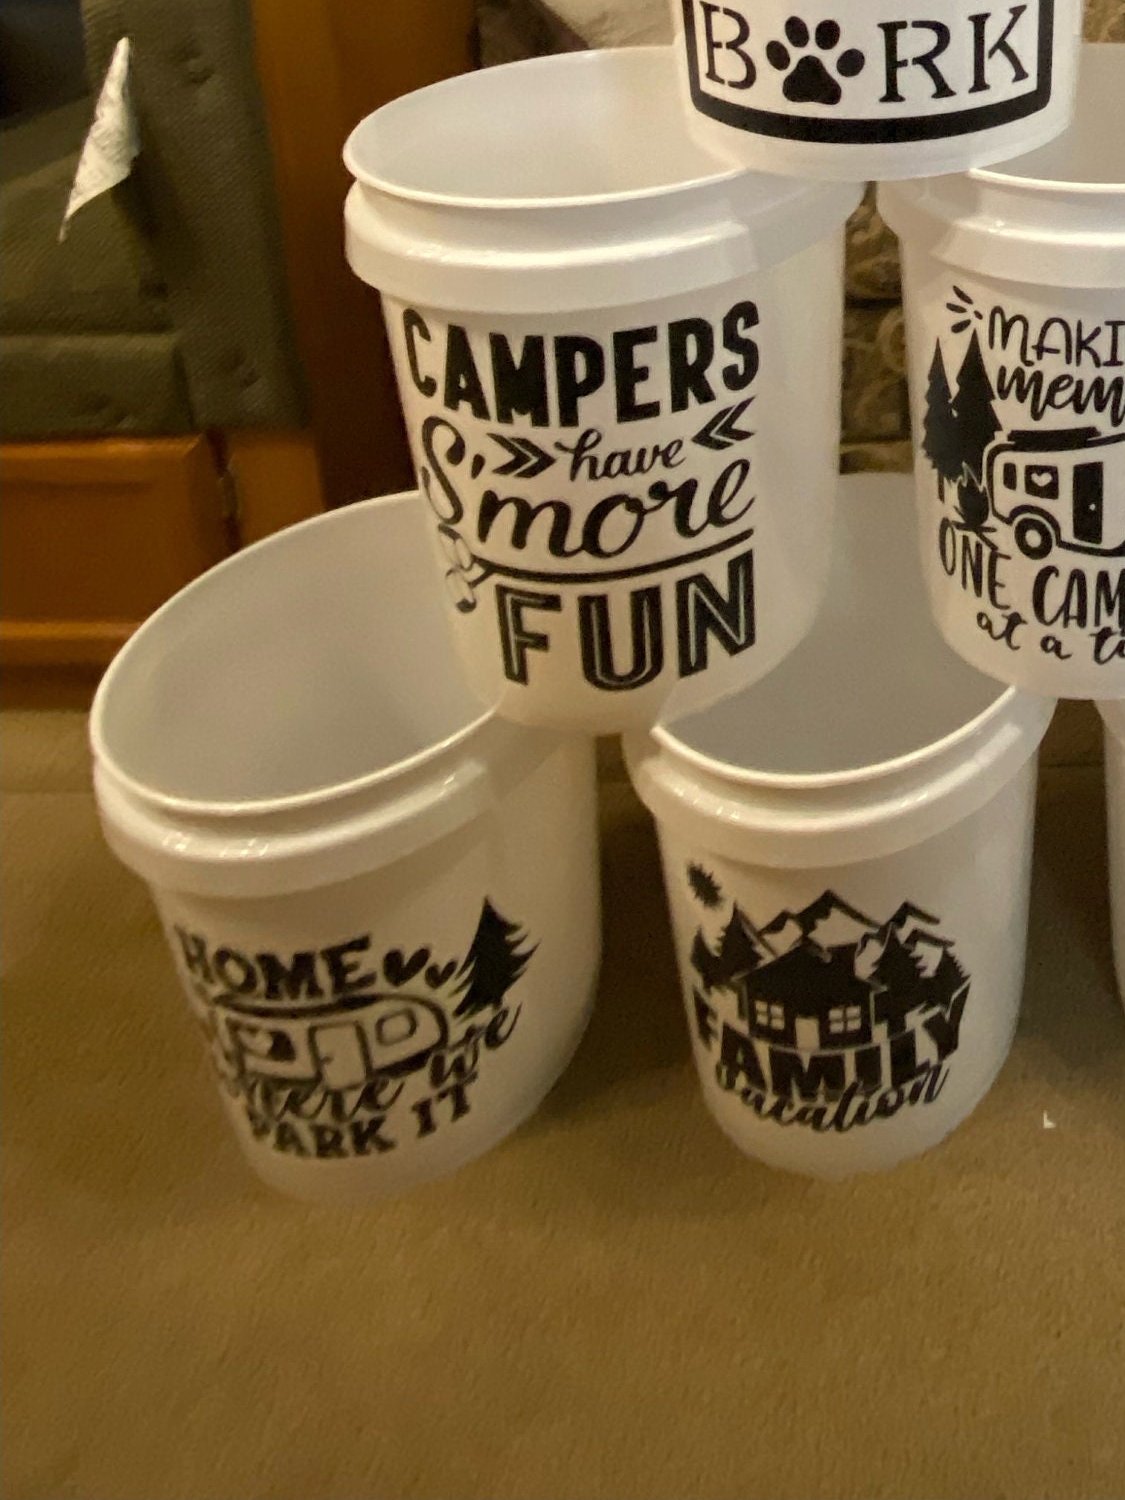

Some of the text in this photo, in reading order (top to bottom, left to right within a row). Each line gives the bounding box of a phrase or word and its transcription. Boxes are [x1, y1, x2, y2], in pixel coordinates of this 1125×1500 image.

[699, 0, 1030, 106] BRK
[402, 300, 760, 428] CAMPERS
[554, 428, 686, 482] have
[938, 516, 1012, 610] ONE
[494, 548, 757, 692] FUN
[976, 611, 1027, 651] at
[1040, 633, 1073, 661] a
[173, 923, 378, 1001] HOME
[411, 1071, 479, 1139] IT
